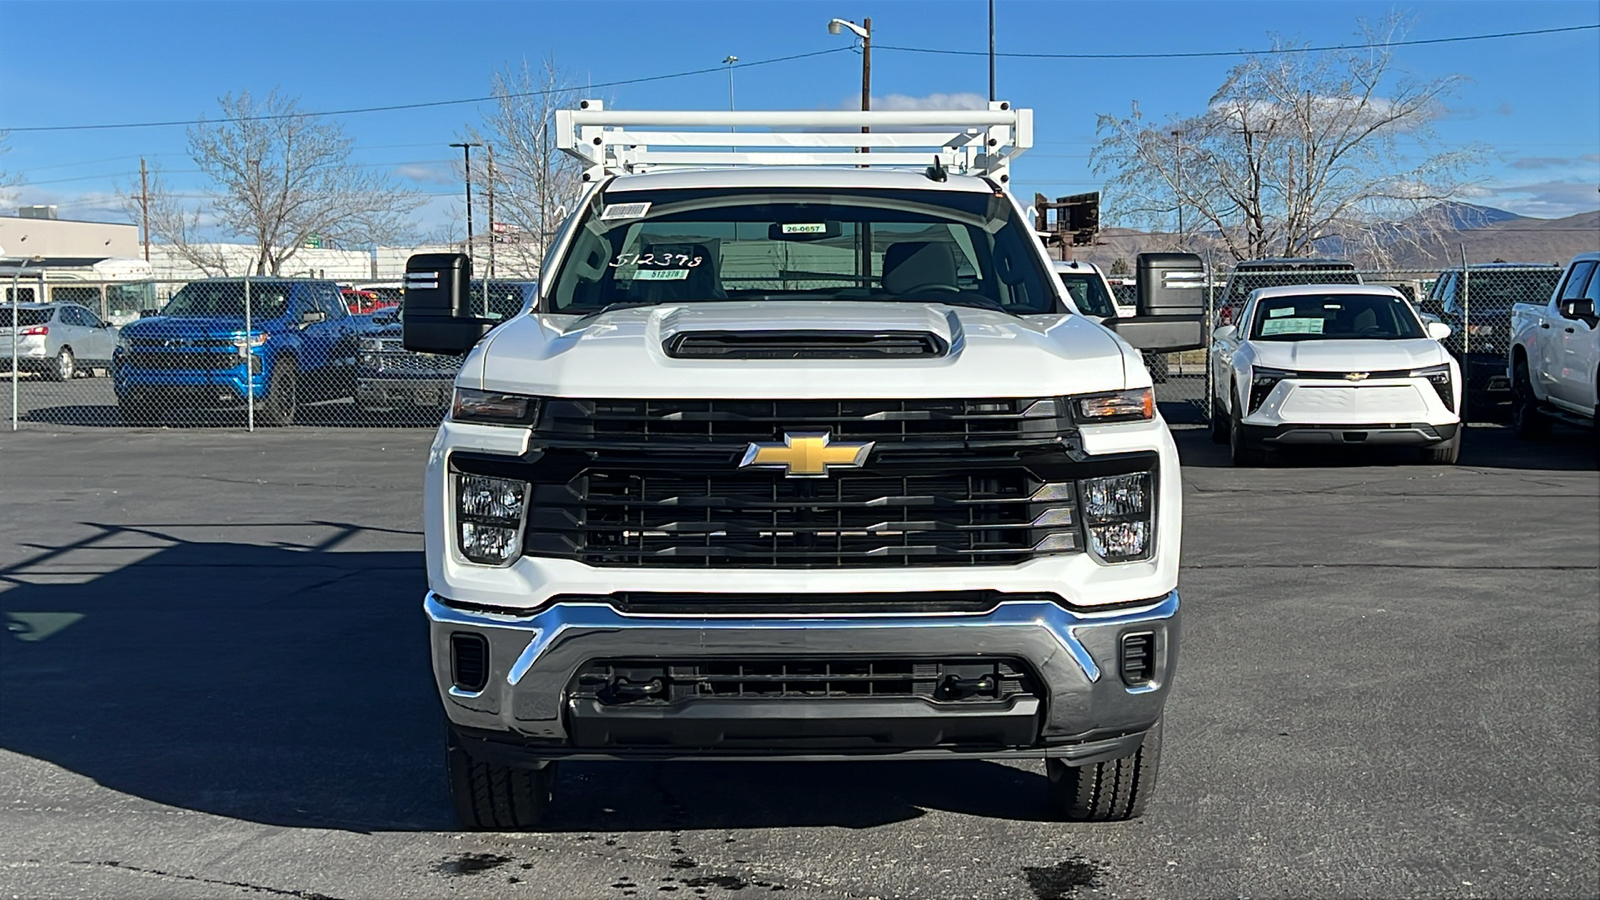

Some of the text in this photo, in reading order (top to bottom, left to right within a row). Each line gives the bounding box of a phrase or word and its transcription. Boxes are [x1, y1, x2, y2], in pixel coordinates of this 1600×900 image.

[786, 225, 821, 233] 26-0657
[608, 253, 703, 268] 512378
[651, 269, 681, 279] 512378
